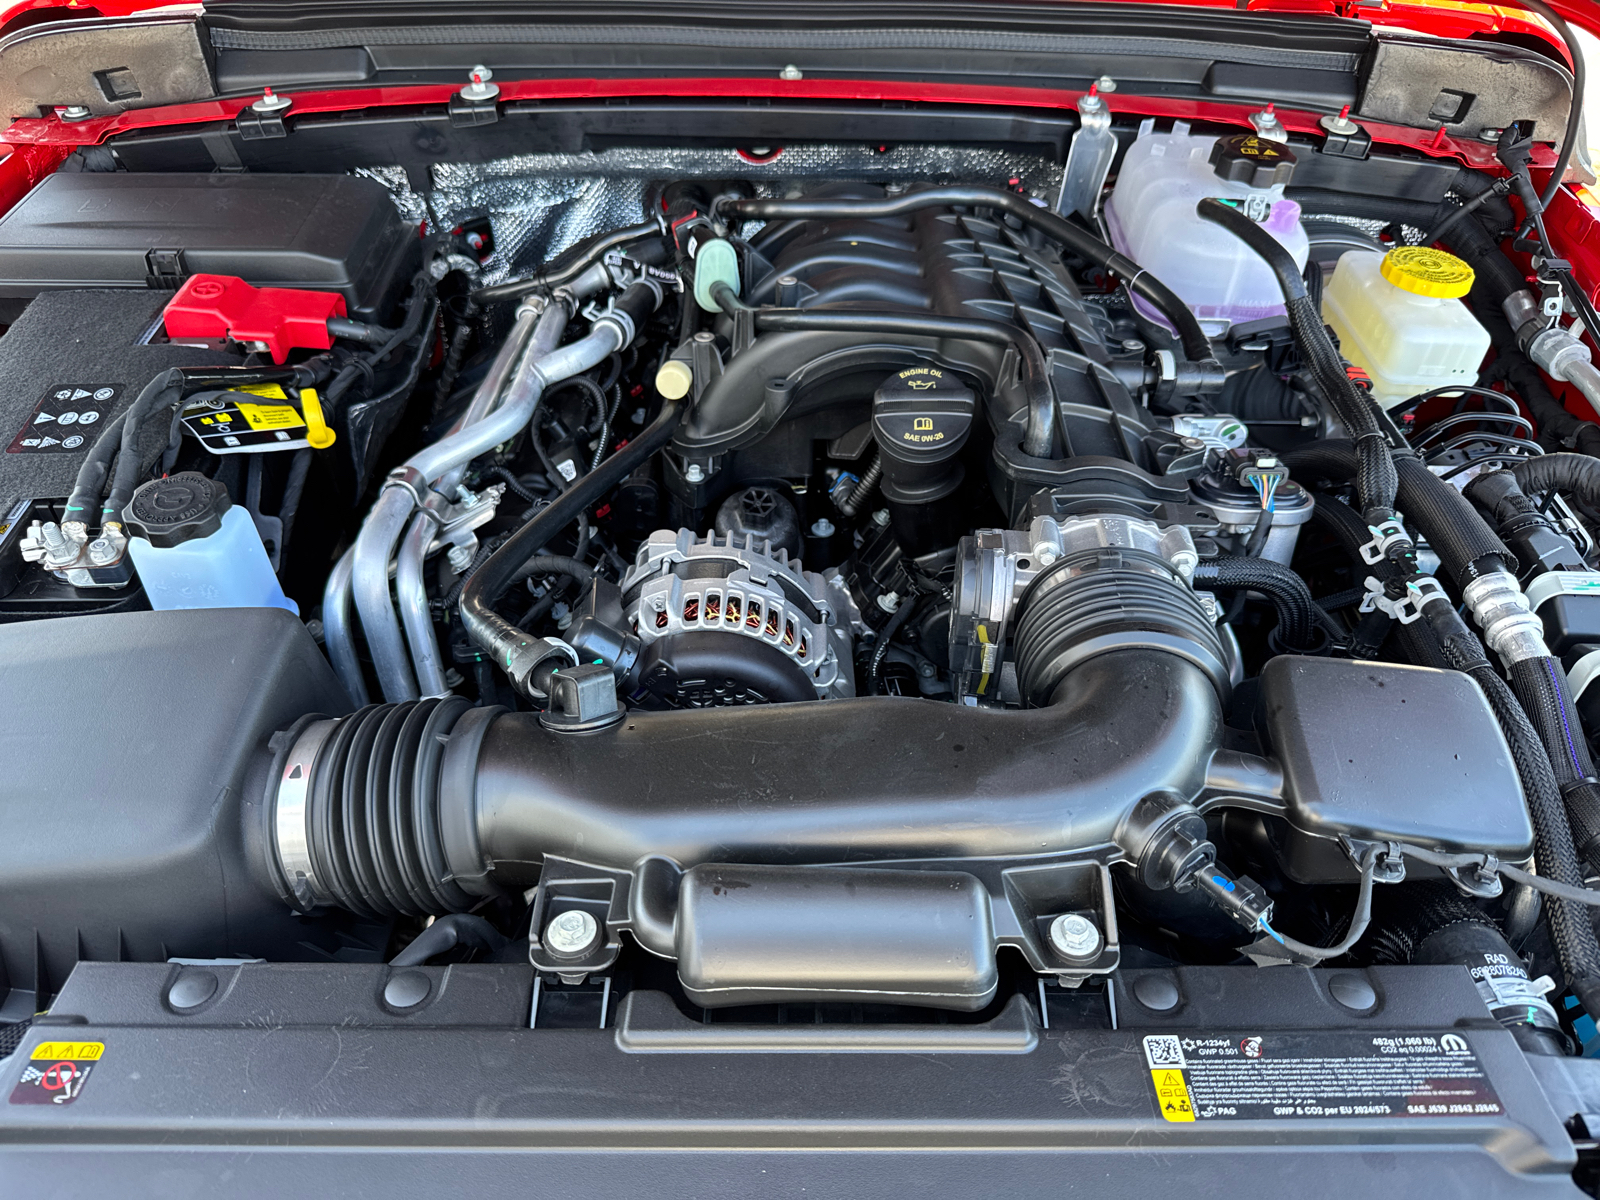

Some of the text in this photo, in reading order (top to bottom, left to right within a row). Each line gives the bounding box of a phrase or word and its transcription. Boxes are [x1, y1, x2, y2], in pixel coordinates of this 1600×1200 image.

[899, 368, 942, 379] ENGINE OIL
[904, 432, 944, 442] SAE 0W-20
[1484, 953, 1508, 964] RAD
[1218, 1106, 1237, 1116] PAG
[1274, 1106, 1294, 1115] GWP
[1304, 1106, 1324, 1114] CO2
[1340, 1106, 1353, 1114] EU
[1408, 1104, 1426, 1114] SAE
